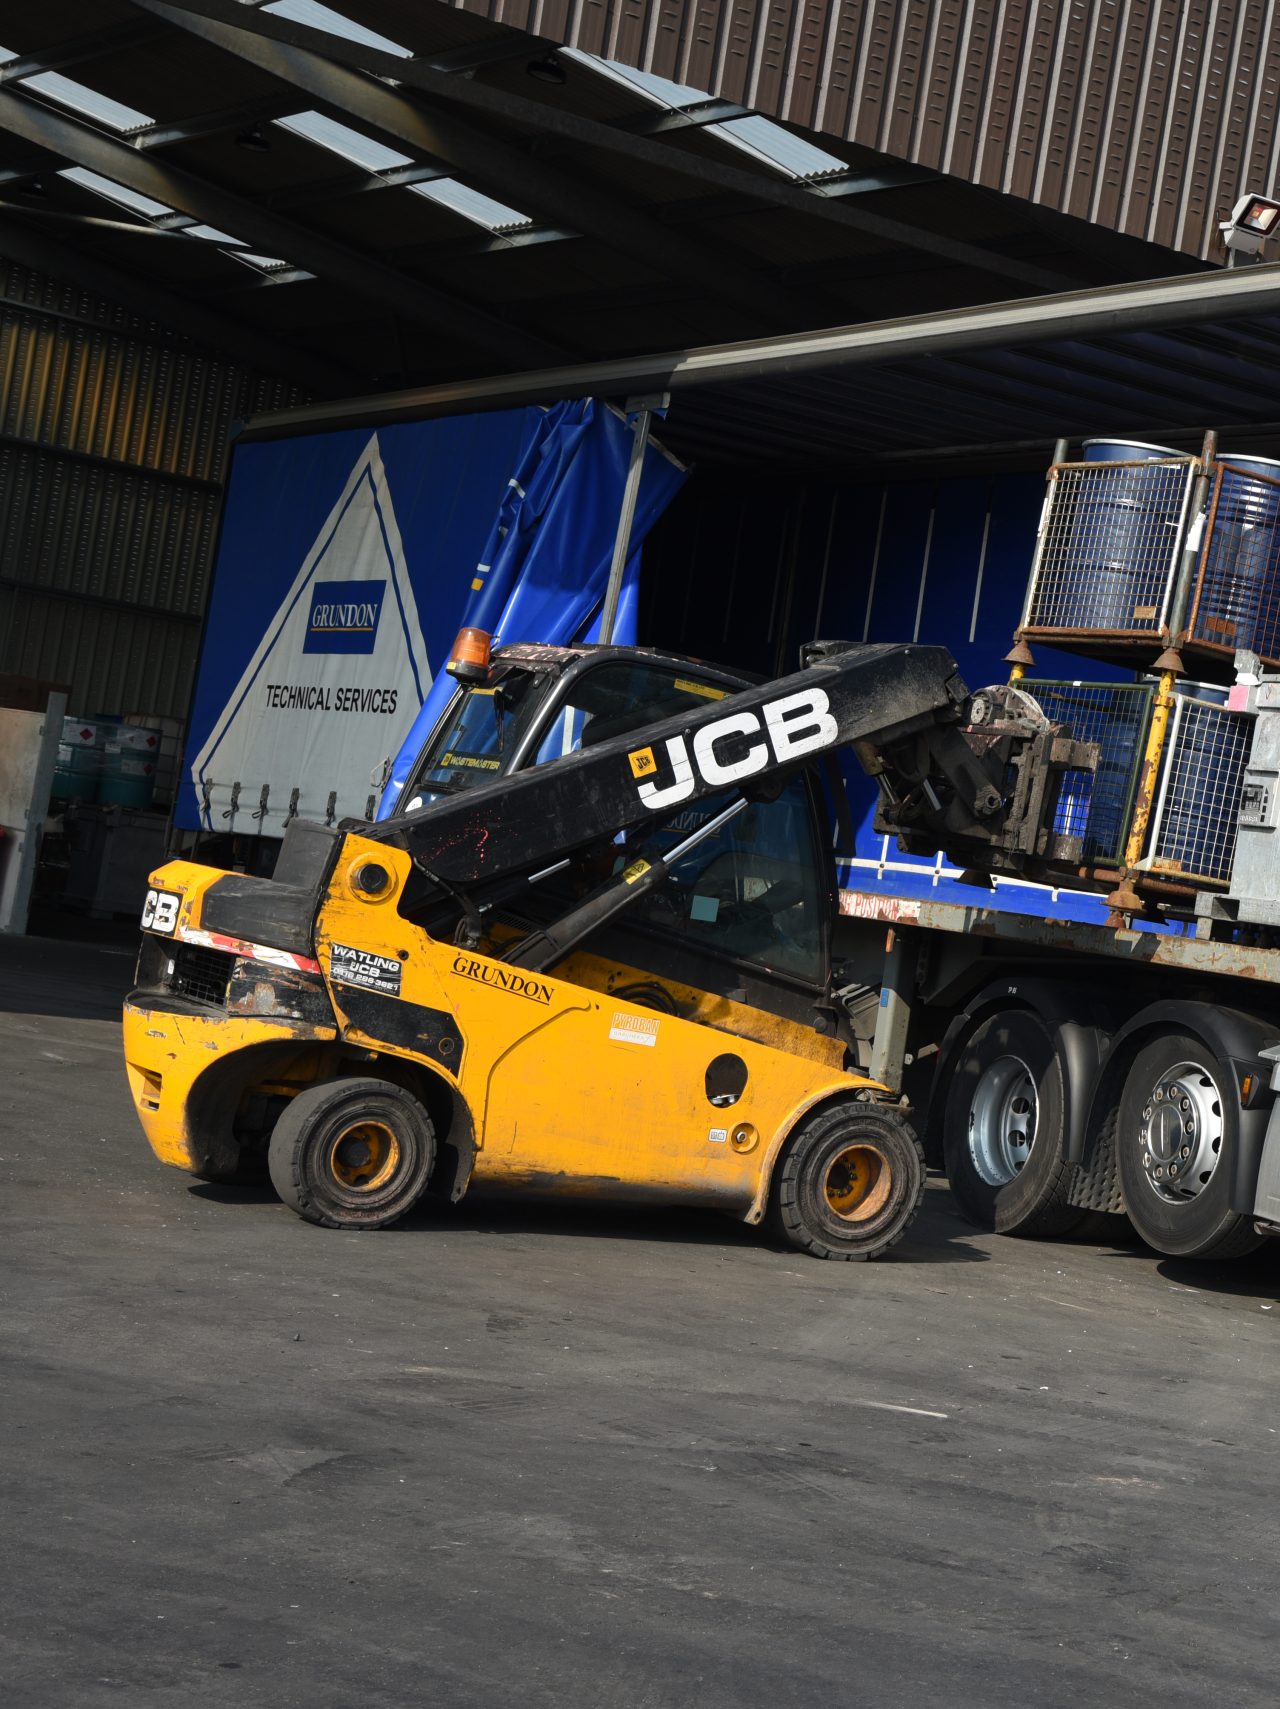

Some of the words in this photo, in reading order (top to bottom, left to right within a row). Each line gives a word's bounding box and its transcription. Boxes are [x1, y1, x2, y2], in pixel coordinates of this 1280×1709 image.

[312, 604, 378, 627] GRUNDON
[266, 685, 331, 710] TECHNICAL
[335, 688, 398, 714] SERVICES
[637, 687, 838, 809] JCB
[635, 754, 651, 772] JCB
[141, 890, 179, 933] CB
[334, 945, 400, 972] WATLING
[349, 961, 381, 978] JCB
[453, 956, 555, 1003] GRUNDON
[612, 1013, 660, 1035] PYROBAN
